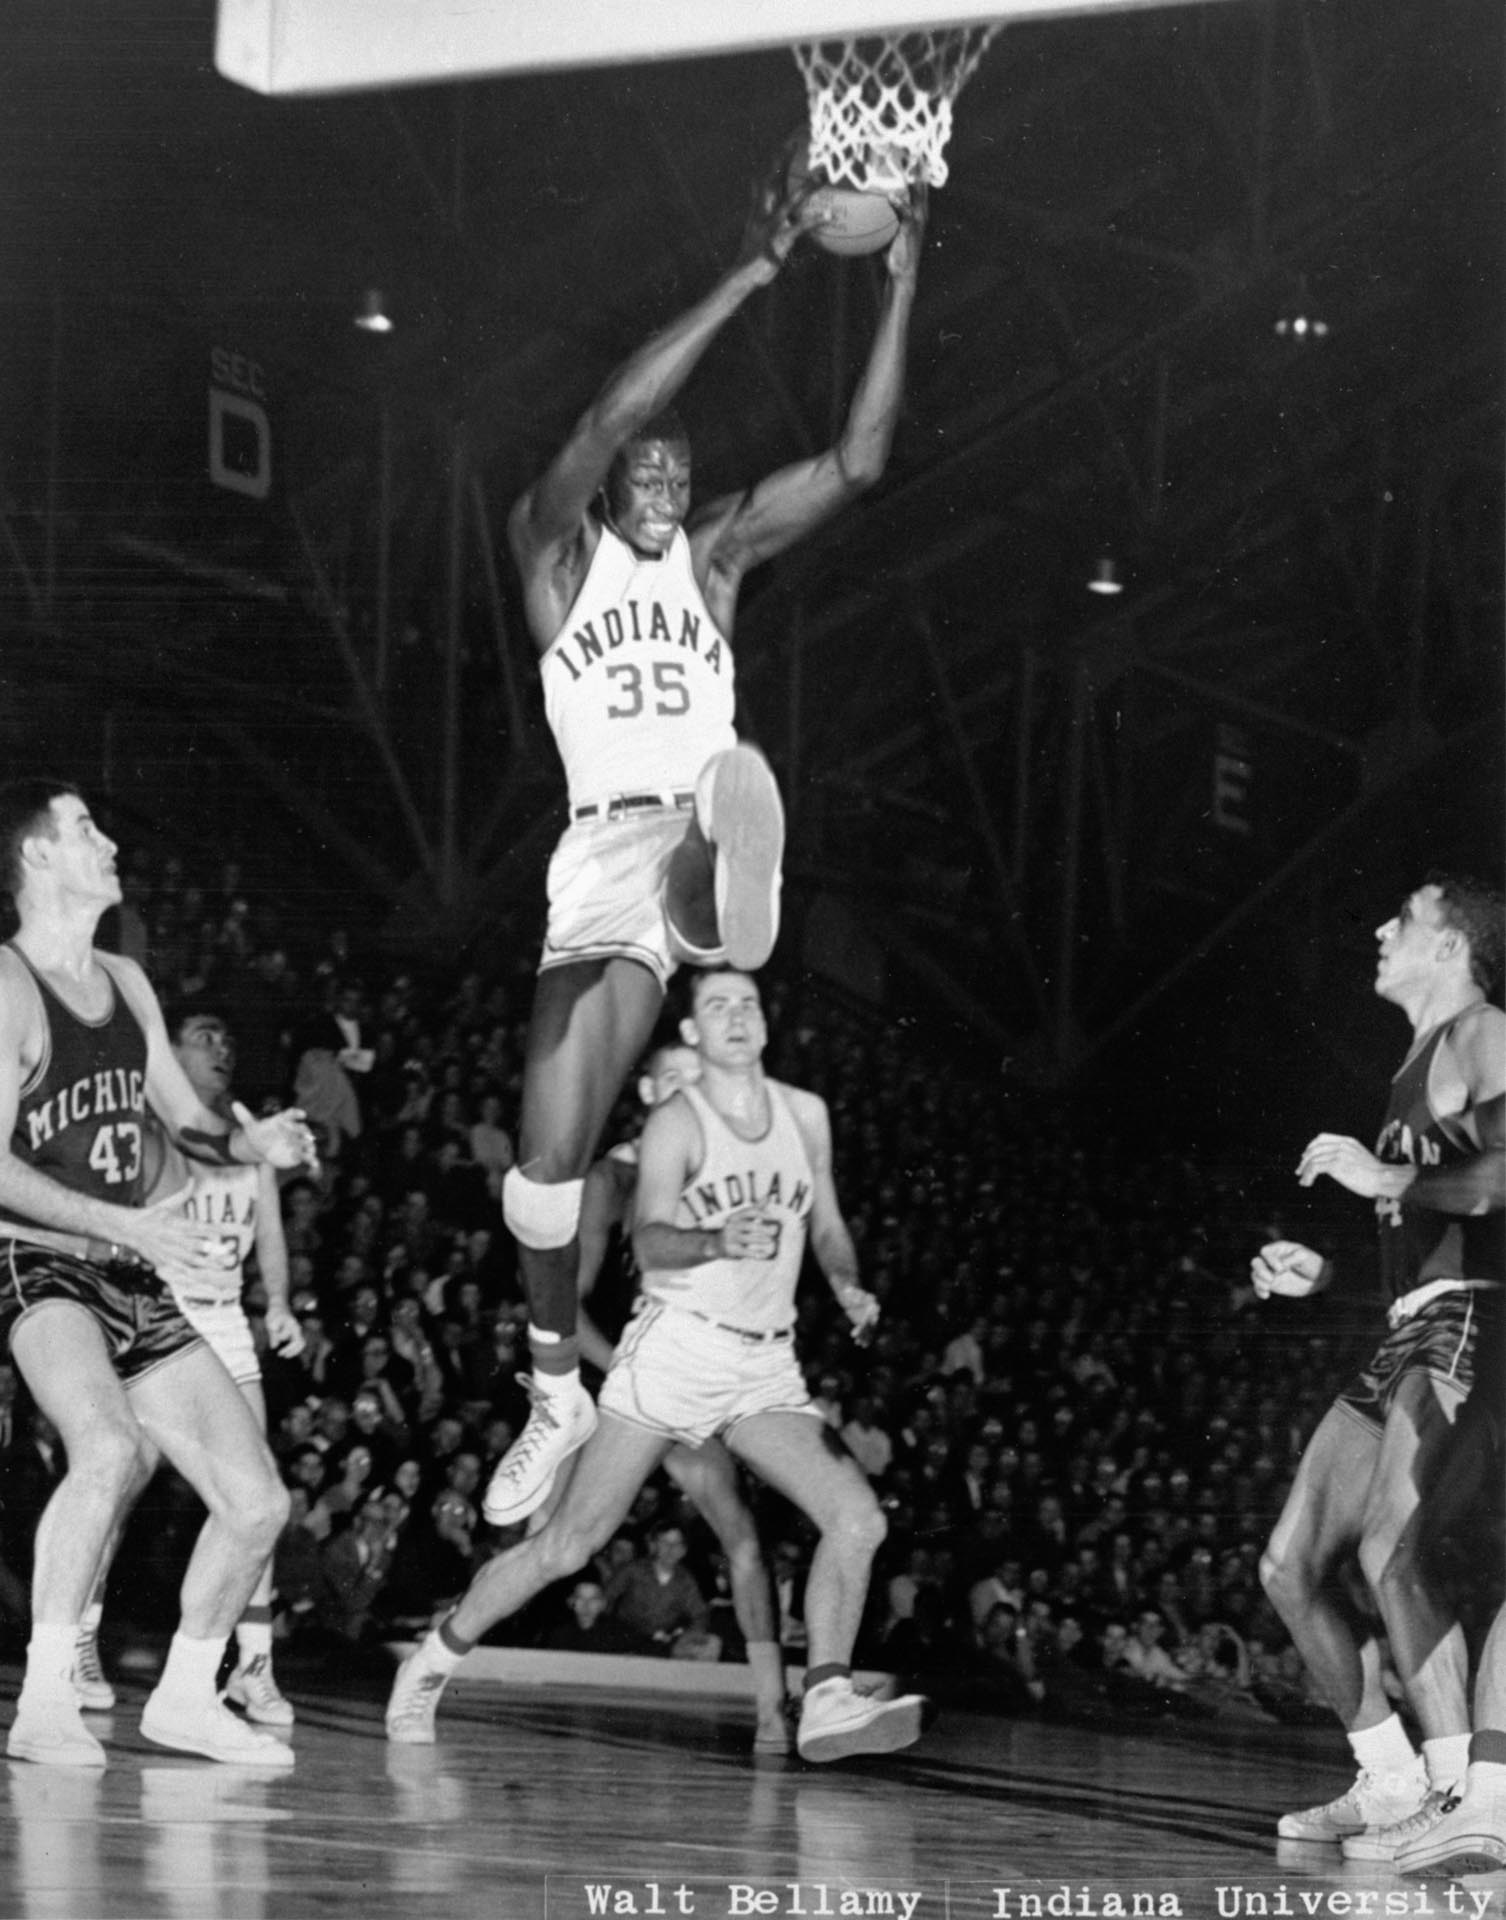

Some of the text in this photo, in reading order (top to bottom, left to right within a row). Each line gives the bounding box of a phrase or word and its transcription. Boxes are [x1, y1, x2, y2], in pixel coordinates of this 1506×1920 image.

[209, 386, 271, 499] D
[556, 600, 721, 682] INDIANA
[606, 661, 690, 719] 35
[88, 1122, 142, 1184] 43
